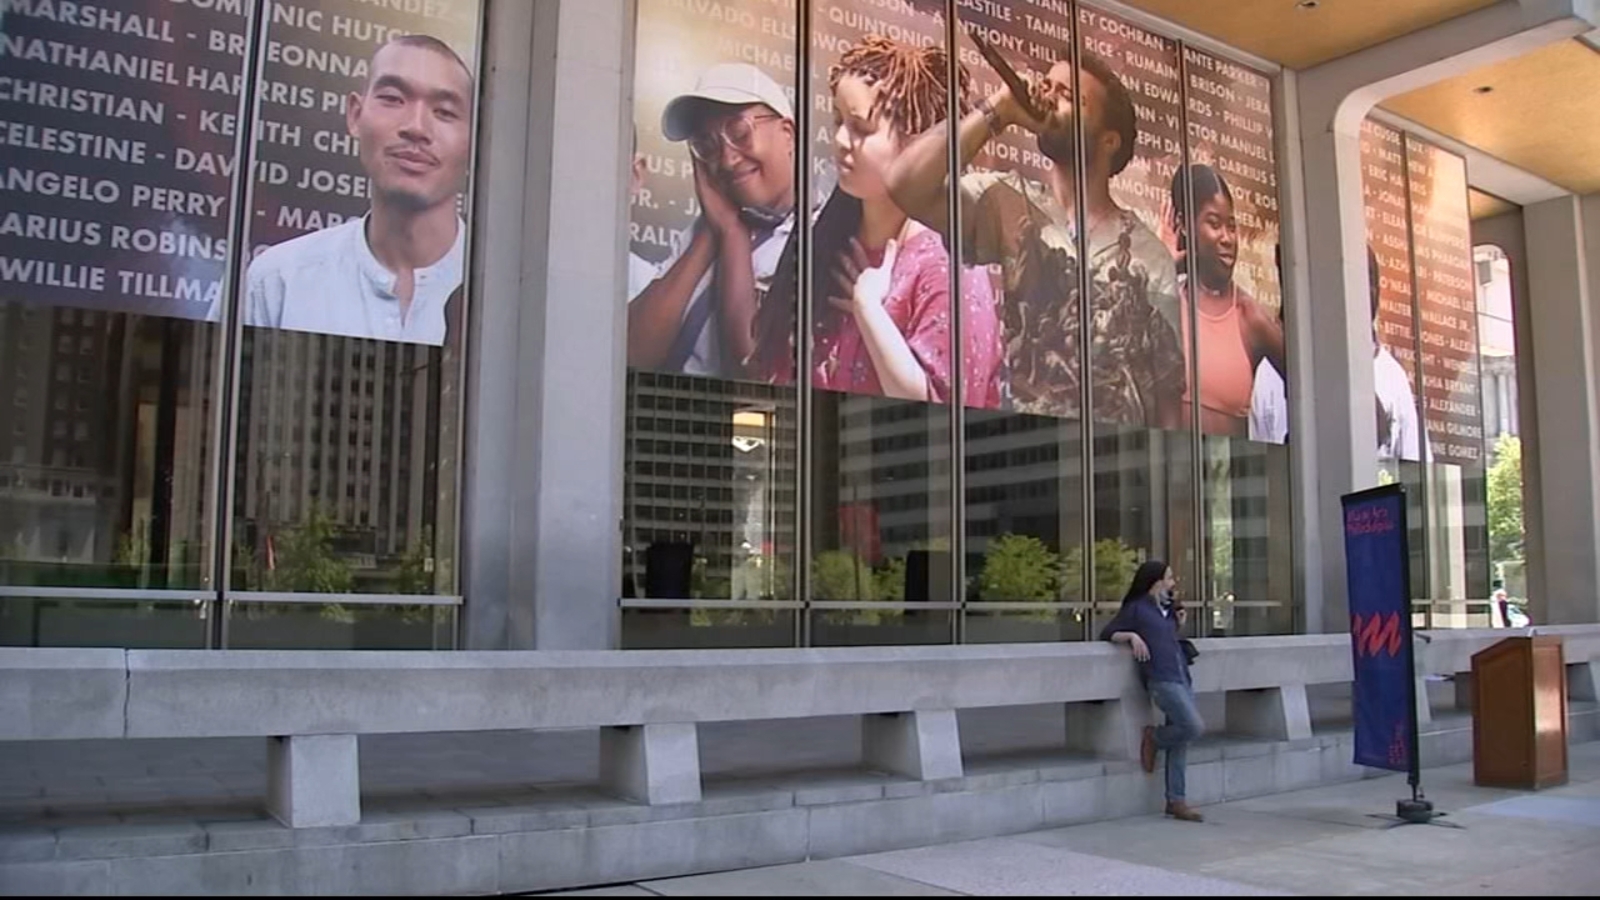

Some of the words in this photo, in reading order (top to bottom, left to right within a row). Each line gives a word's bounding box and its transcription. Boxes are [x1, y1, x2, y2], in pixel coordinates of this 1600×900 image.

[4, 0, 174, 44] MARSHALL
[333, 15, 410, 44] HUTC
[1025, 14, 1070, 43] TAMIR
[0, 32, 180, 86] NATHANIEL
[1183, 47, 1213, 71] ANTE
[0, 76, 165, 125] CHRISTIAN
[0, 166, 120, 203] NGELO
[132, 184, 227, 217] PERRY
[0, 255, 106, 291] WILLIE
